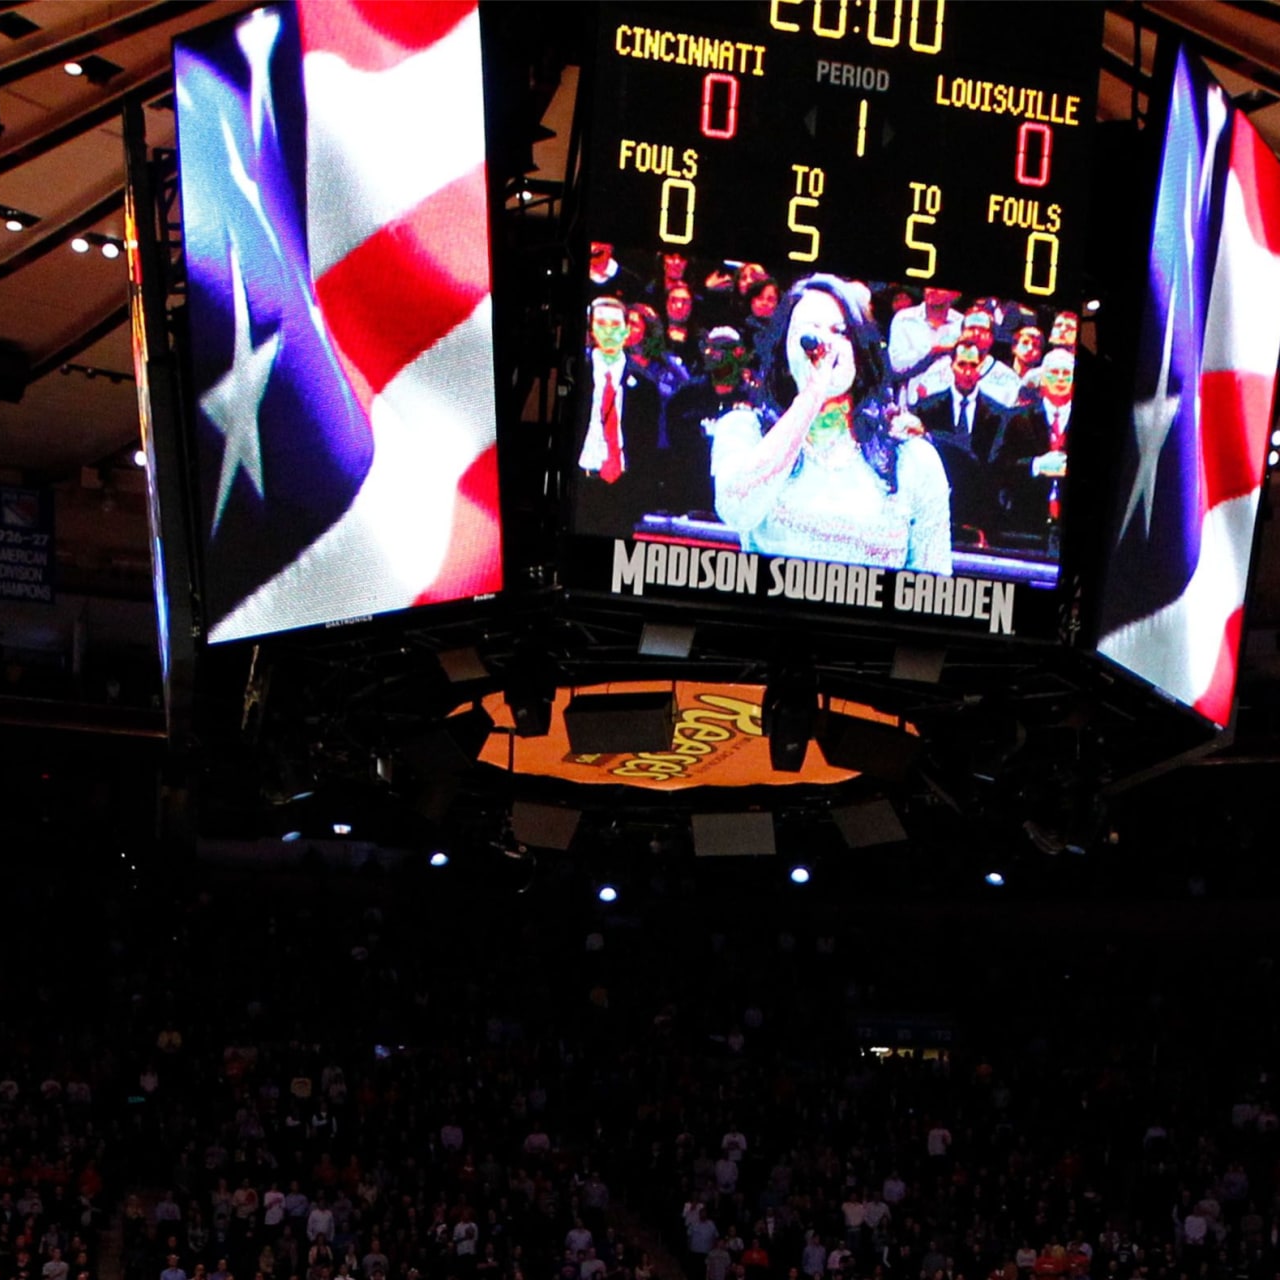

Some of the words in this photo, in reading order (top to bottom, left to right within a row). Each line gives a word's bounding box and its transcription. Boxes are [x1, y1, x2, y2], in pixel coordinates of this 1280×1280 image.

[616, 25, 765, 76] CINCINNATI
[817, 60, 890, 92] PERIOD
[701, 72, 738, 139] 0
[856, 99, 869, 157] 1
[937, 75, 1080, 126] LOUISVILLE
[620, 139, 698, 178] FOULS
[792, 165, 824, 197] TO
[1015, 122, 1052, 187] 0
[659, 178, 696, 244] 0
[909, 182, 941, 215] TO
[988, 195, 1062, 232] FOULS
[787, 197, 820, 262] 5
[906, 213, 937, 279] 5
[1024, 231, 1059, 296] 0
[611, 539, 759, 596] MADISON
[767, 557, 885, 609] SQUARE
[895, 570, 1016, 635] GARDEN
